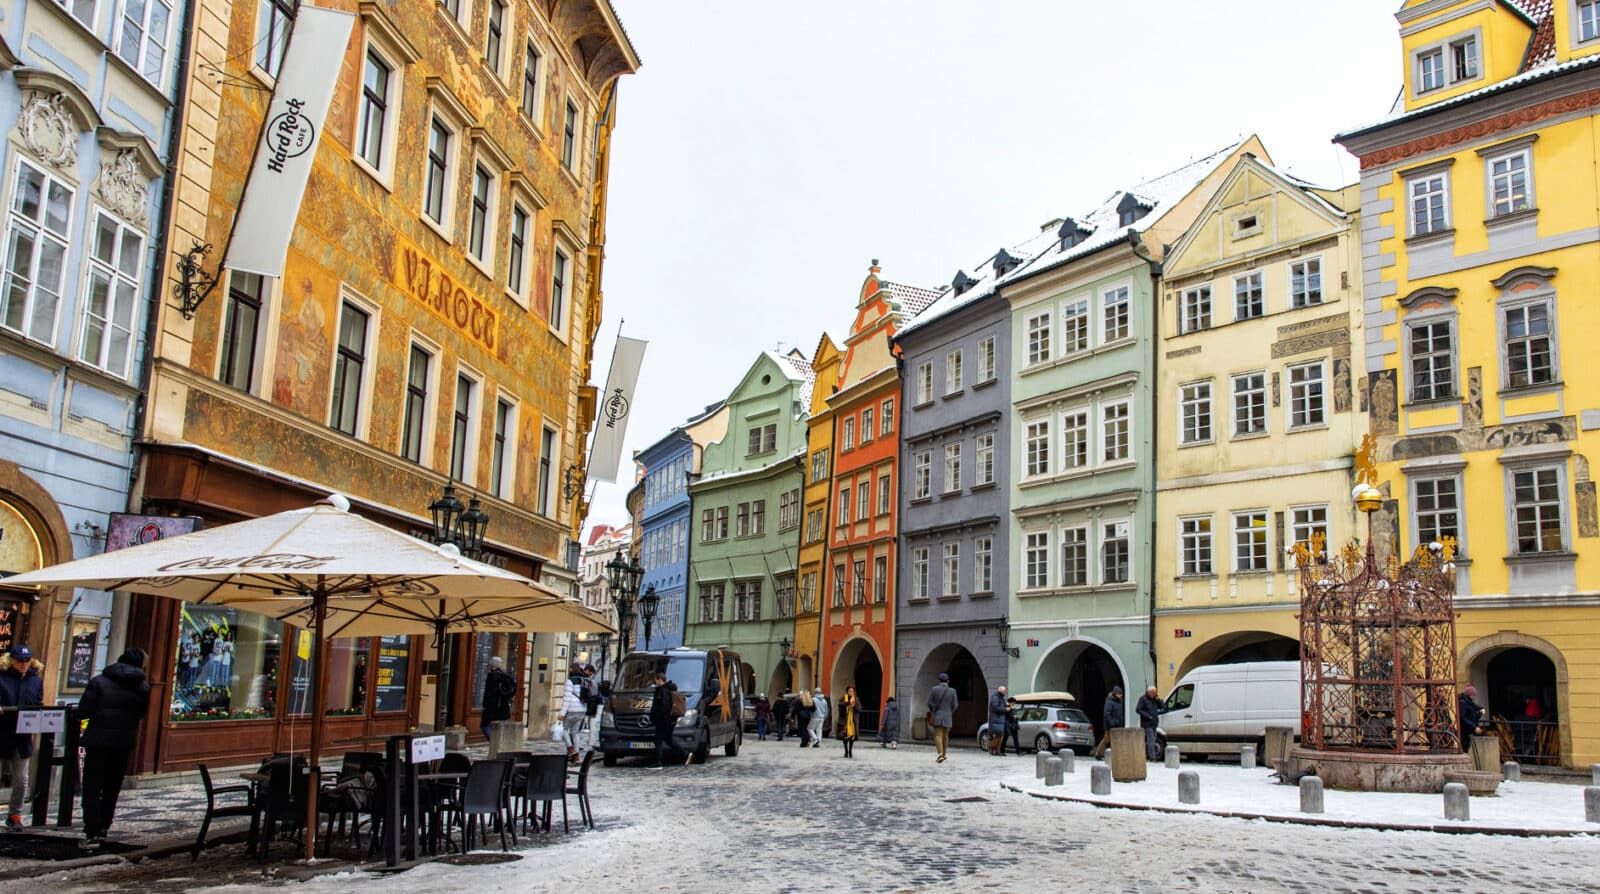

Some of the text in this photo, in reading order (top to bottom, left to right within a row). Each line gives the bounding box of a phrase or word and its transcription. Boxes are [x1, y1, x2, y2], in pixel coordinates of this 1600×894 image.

[267, 98, 306, 173] Hard Rock
[296, 127, 307, 147] CAFE
[606, 388, 623, 428] Hard Rock
